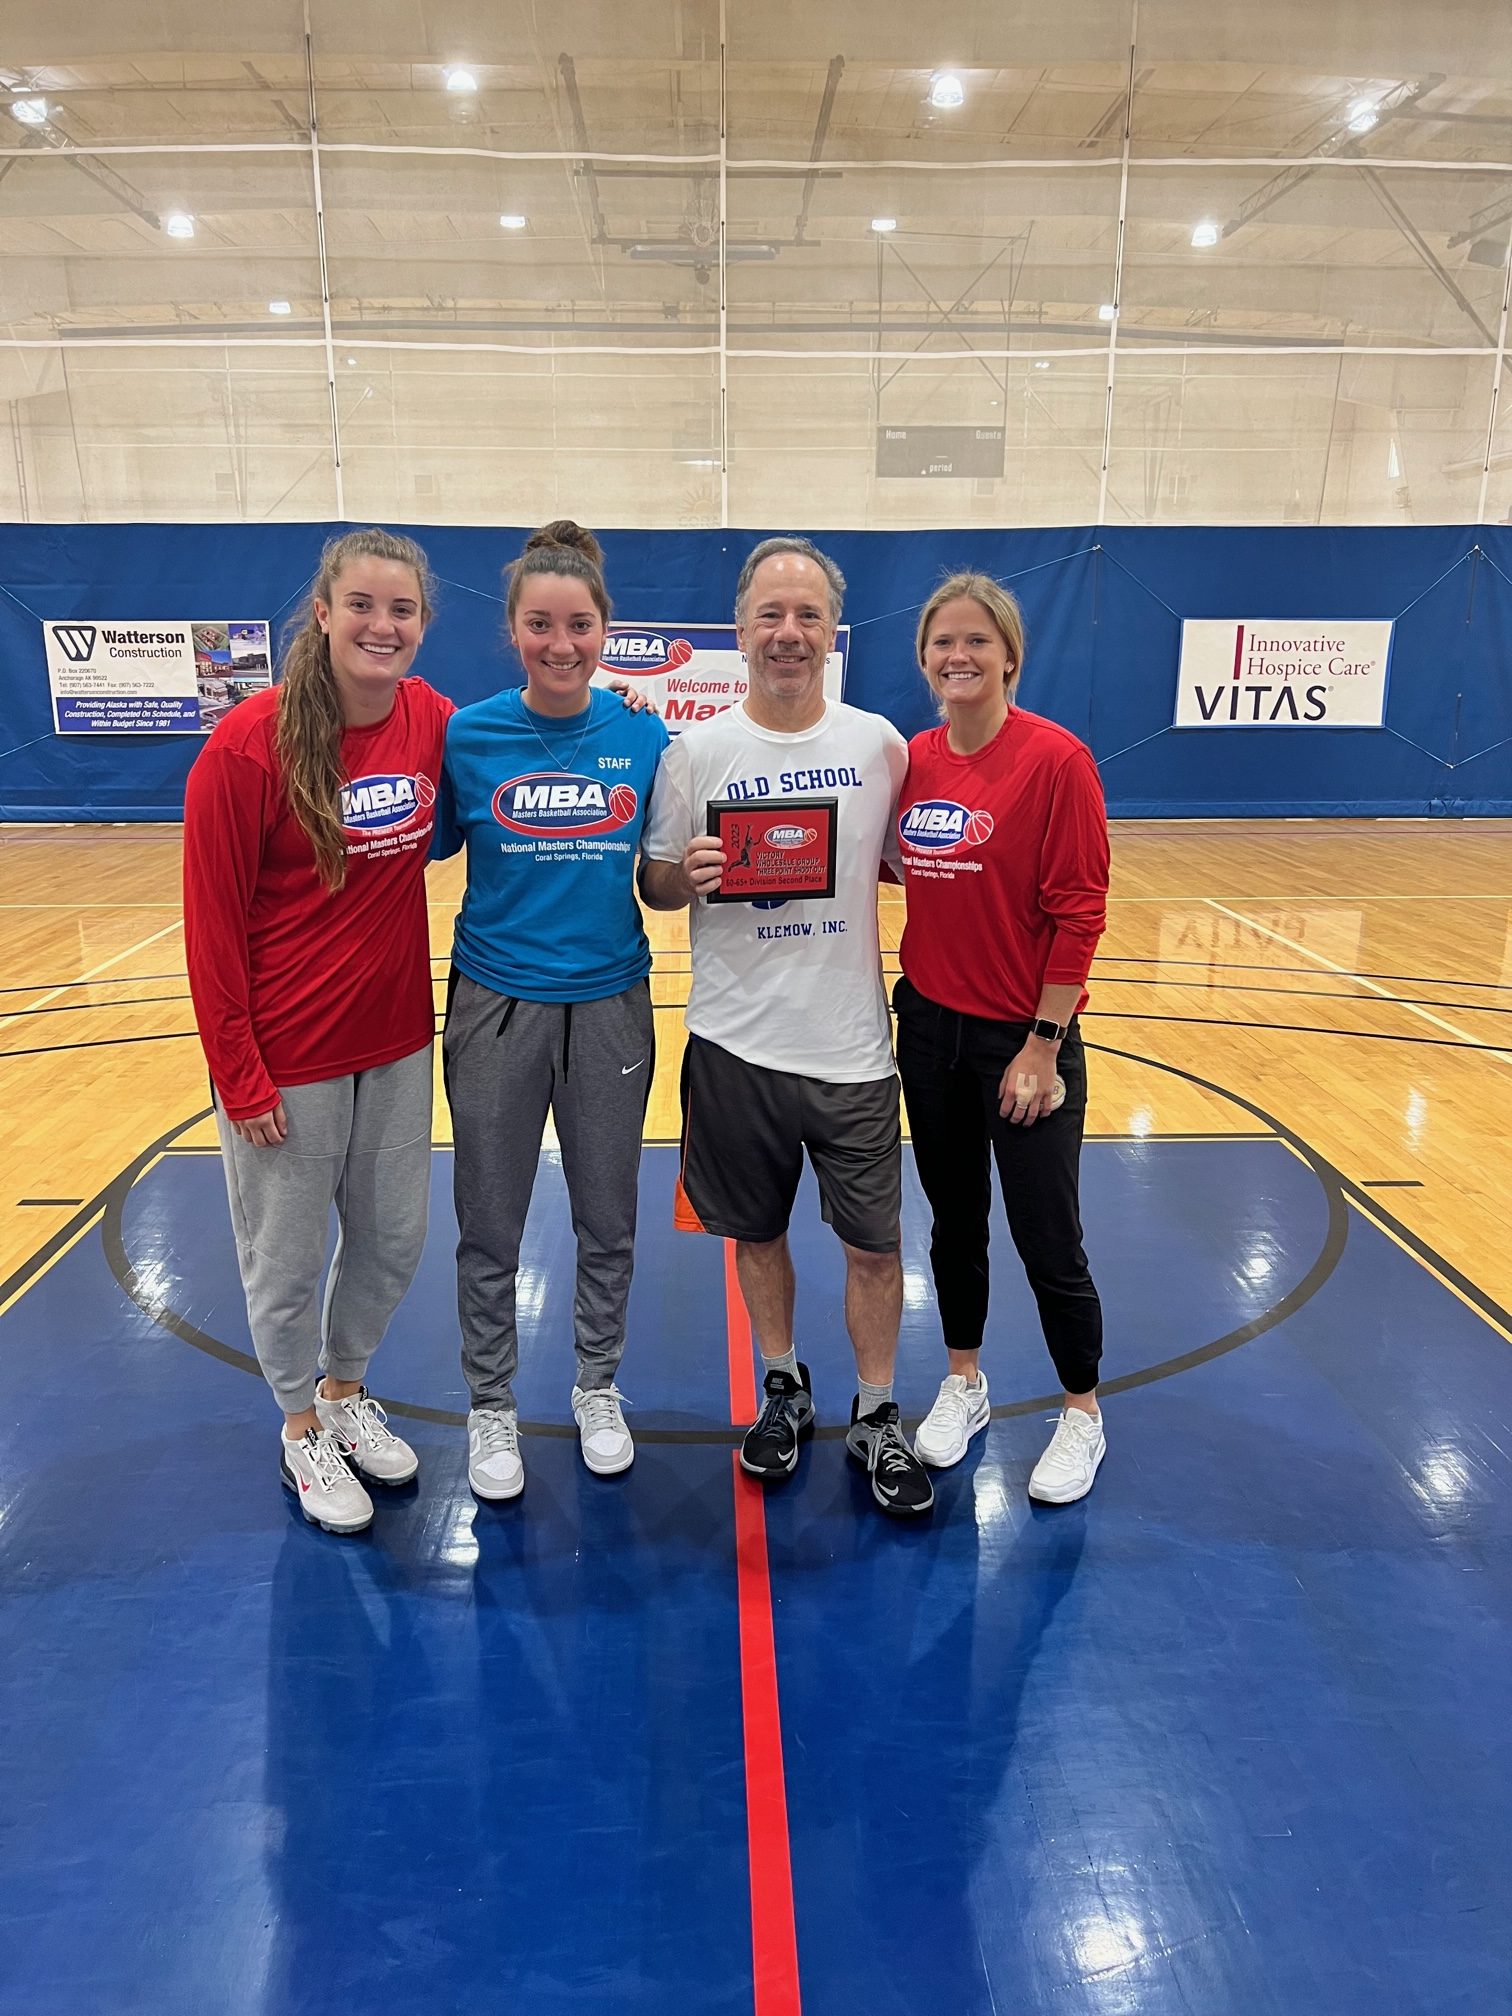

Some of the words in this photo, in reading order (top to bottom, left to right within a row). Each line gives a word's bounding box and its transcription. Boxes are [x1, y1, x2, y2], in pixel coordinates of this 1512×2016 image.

[885, 430, 906, 440] Home
[929, 463, 953, 473] period
[101, 630, 185, 644] Watterson
[1249, 634, 1346, 652] Innovative
[109, 647, 182, 659] Construction
[602, 638, 666, 656] MBA
[1246, 657, 1322, 681] Hospice
[666, 678, 730, 692] Welcome
[734, 680, 748, 694] to
[76, 701, 106, 709] Providing
[144, 701, 160, 709] Safe,
[160, 701, 183, 709] Quality
[1194, 685, 1327, 720] VITAS
[64, 710, 106, 718] Construction,
[106, 710, 140, 719] Completed
[142, 710, 151, 718] On
[152, 710, 182, 718] Schedule,
[182, 710, 196, 718] and
[112, 720, 136, 728] Budget
[598, 757, 632, 770] STAFF
[726, 776, 770, 801] OLD
[780, 768, 862, 793] SCHOOL
[340, 778, 414, 815] MBA
[512, 784, 606, 810] MBA
[343, 814, 366, 824] Masters
[366, 808, 392, 820] Basketball
[512, 810, 537, 818] Masters
[538, 808, 572, 818] Basketball
[572, 808, 608, 816] Association
[905, 808, 964, 832] MBA
[772, 829, 804, 840] MBA
[370, 836, 398, 850] Masters
[500, 842, 536, 853] National
[538, 840, 574, 852] Masters
[576, 840, 631, 853] Championships
[367, 850, 380, 860] Coral
[402, 842, 418, 852] Florida
[535, 854, 552, 862] Coral
[554, 852, 580, 862] Springs,
[582, 852, 604, 860] Florida
[756, 852, 785, 860] VICTORY
[912, 856, 935, 868] Masters
[936, 859, 982, 872] Championships
[910, 868, 922, 876] Coral
[749, 876, 778, 886] Division
[779, 876, 804, 884] Second
[804, 874, 822, 882] Place
[757, 923, 816, 939] KLEMOW,
[822, 920, 848, 934] INC.
